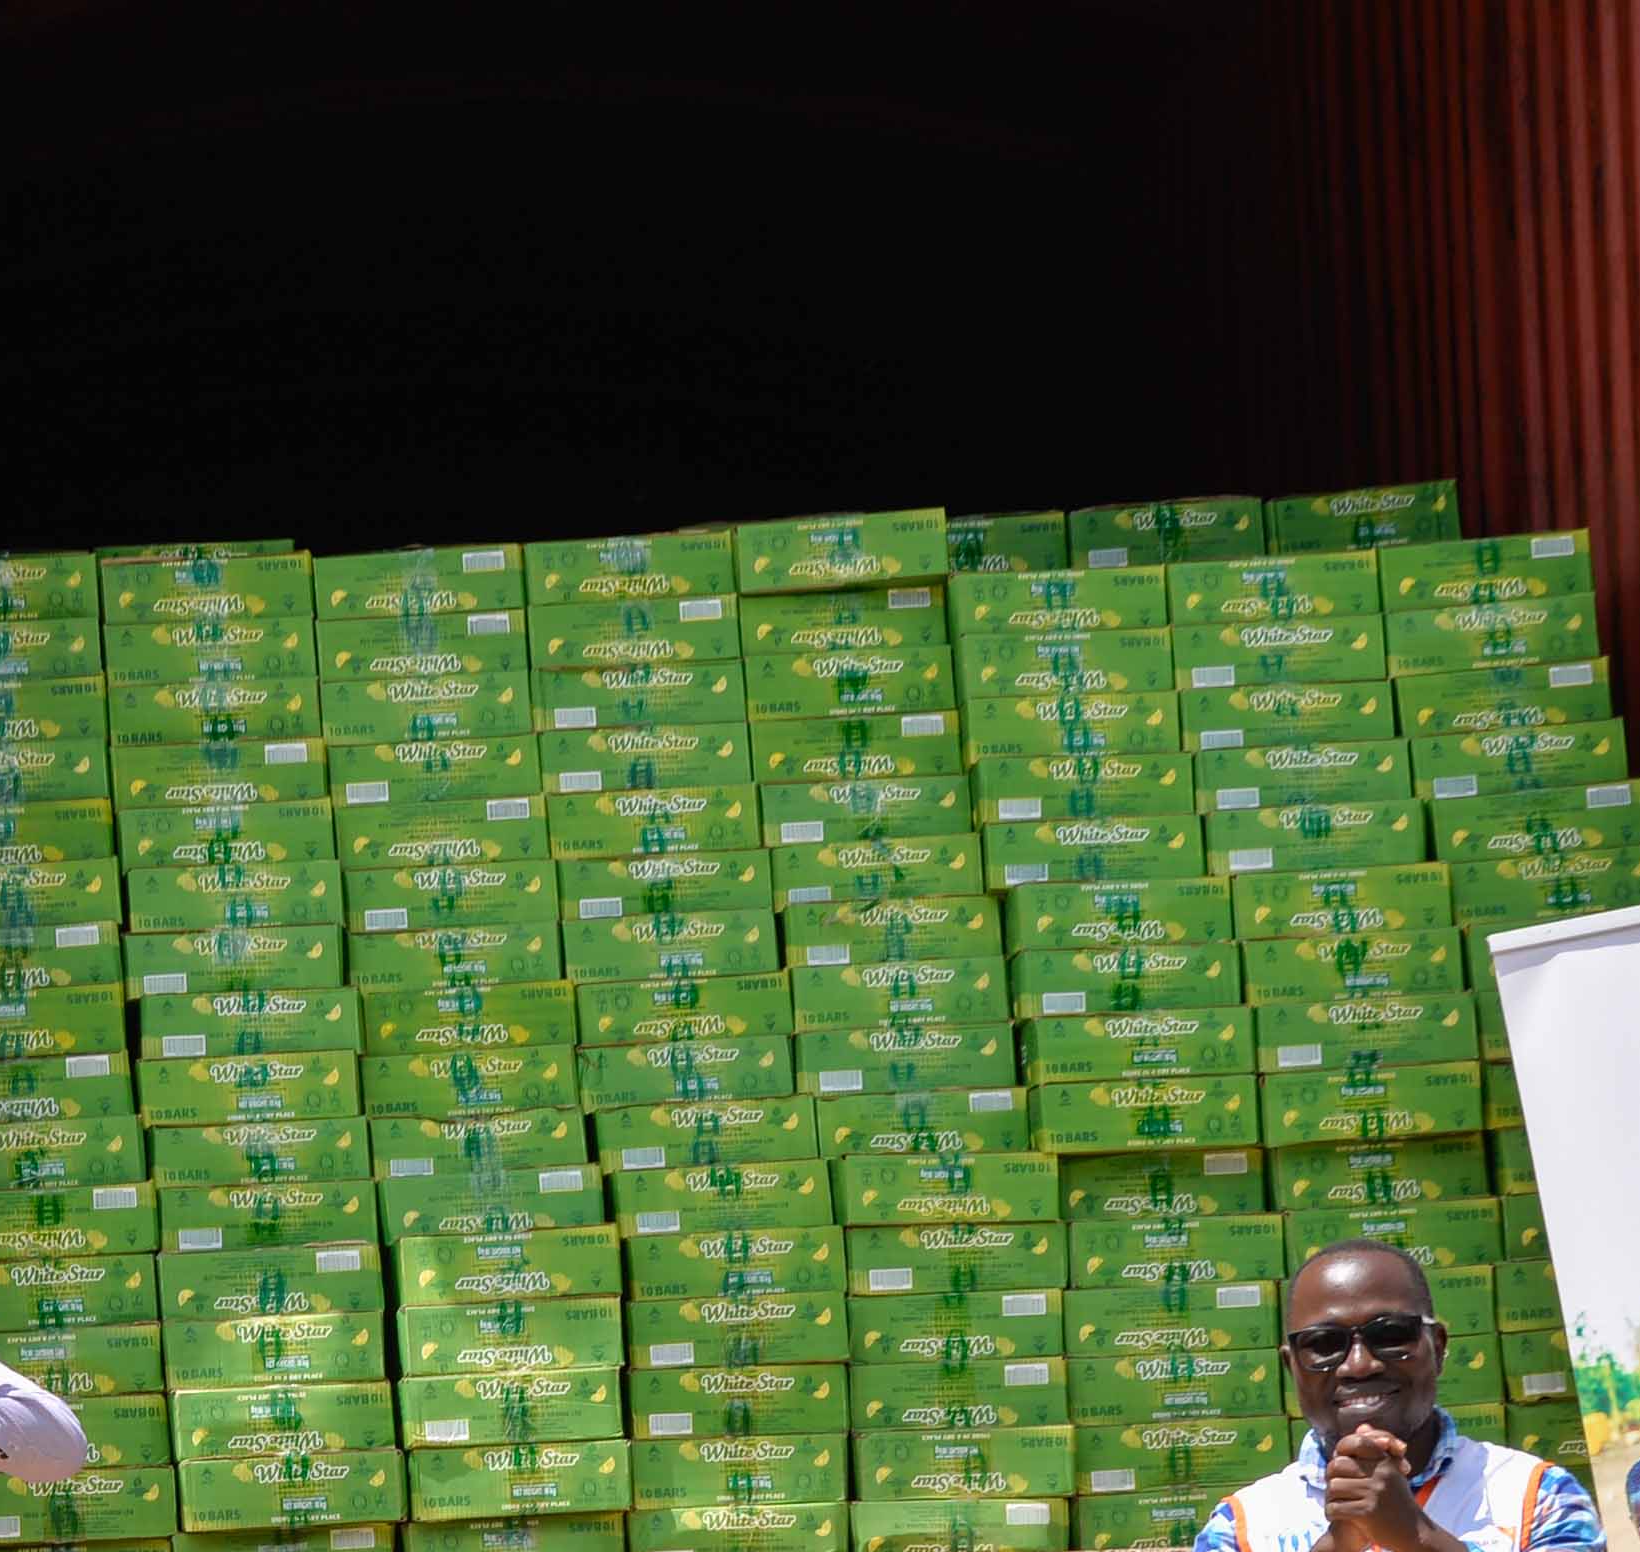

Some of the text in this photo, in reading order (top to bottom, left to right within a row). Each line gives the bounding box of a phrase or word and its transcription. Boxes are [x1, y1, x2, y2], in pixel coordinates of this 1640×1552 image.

[701, 1301, 796, 1323] White Star
[1143, 1427, 1237, 1450] White Star
[700, 1441, 795, 1462] White Star
[703, 1509, 796, 1529] White Star
